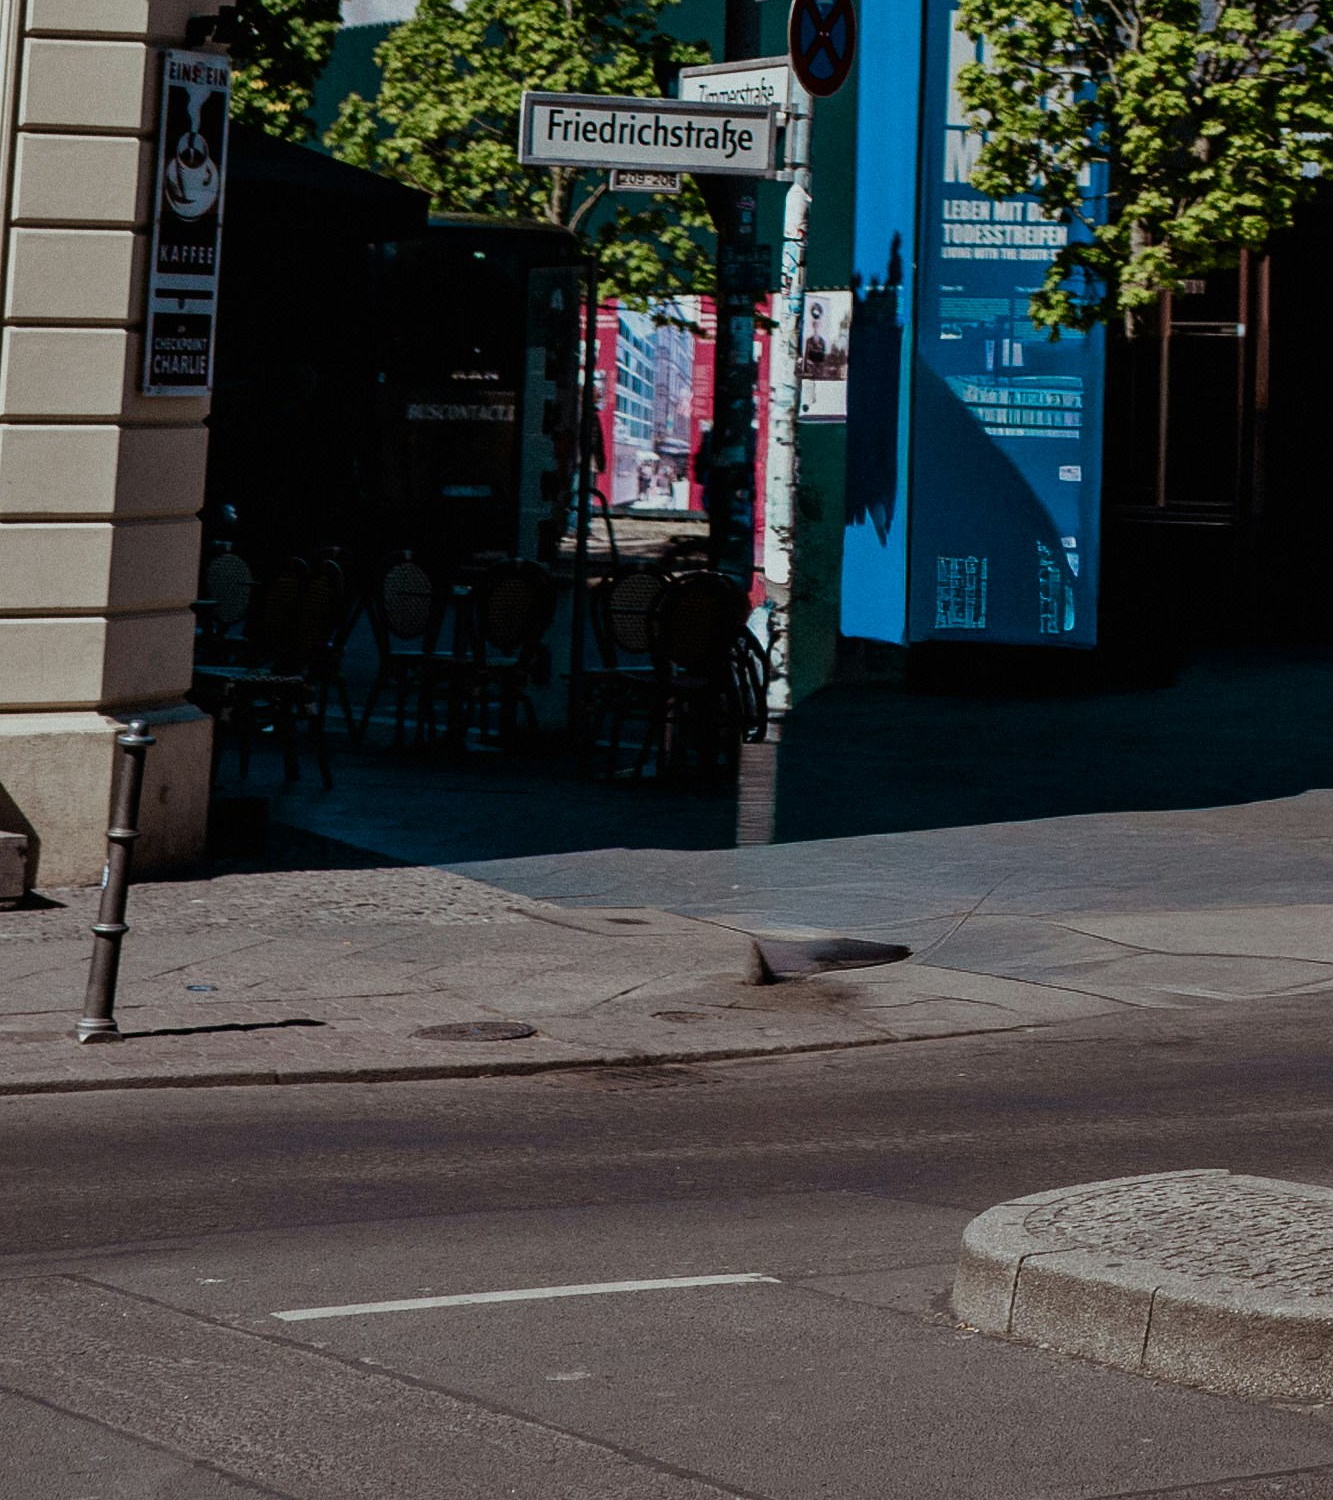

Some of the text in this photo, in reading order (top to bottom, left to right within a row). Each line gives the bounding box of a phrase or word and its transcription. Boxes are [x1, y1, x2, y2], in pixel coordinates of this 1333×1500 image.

[168, 61, 228, 88] EINSEIN
[547, 108, 754, 159] Friedrichstraße
[942, 199, 991, 221] LEBEN
[993, 200, 1025, 222] MIT
[942, 223, 1069, 246] TODESSTREIFEN
[160, 243, 214, 265] KAFFEE
[153, 353, 208, 376] CHARLIE
